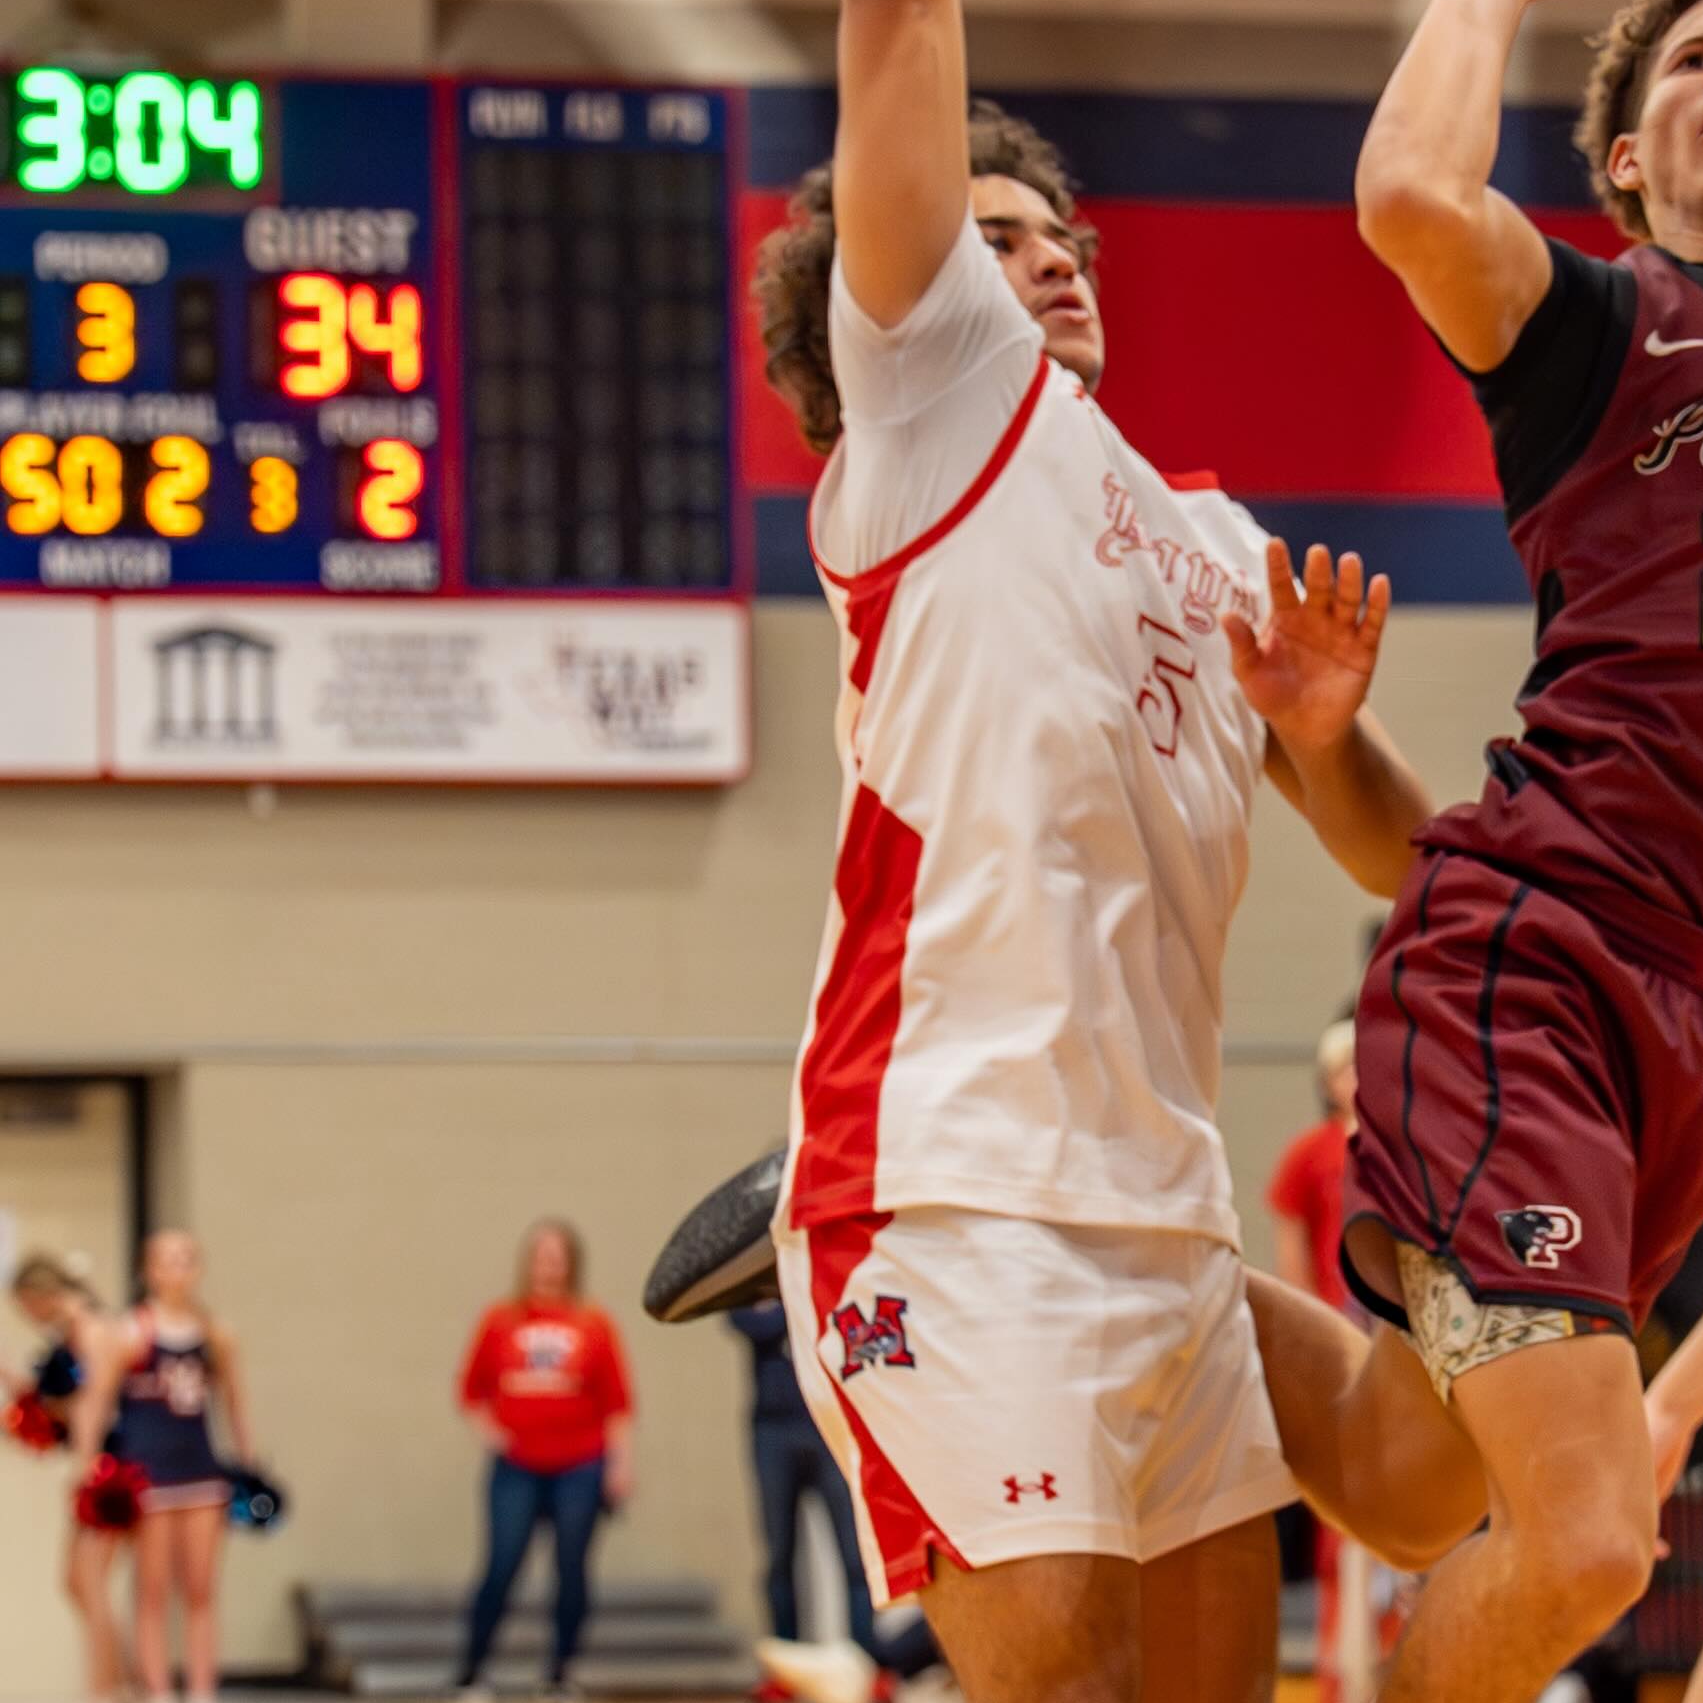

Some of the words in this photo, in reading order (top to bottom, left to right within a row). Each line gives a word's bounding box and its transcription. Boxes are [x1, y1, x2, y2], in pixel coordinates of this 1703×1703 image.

[17, 67, 261, 193] 3:04
[243, 206, 416, 273] GUEST
[76, 282, 136, 383] 3
[278, 272, 423, 400] 34
[0, 433, 123, 535] 50
[145, 435, 210, 537] 2
[359, 437, 425, 540] 2
